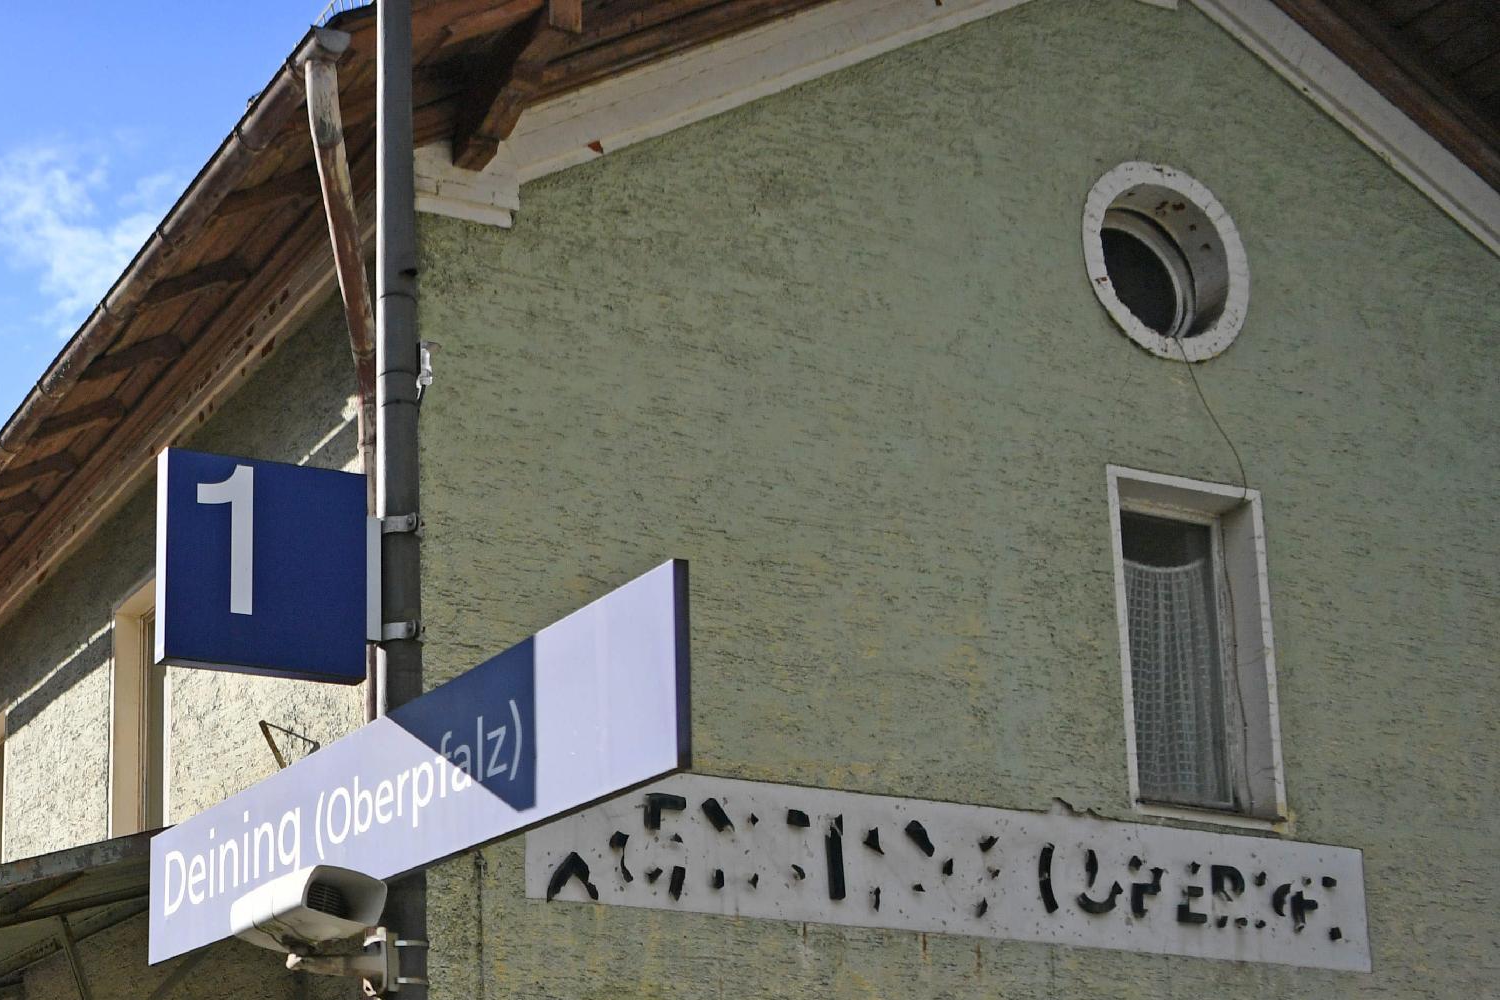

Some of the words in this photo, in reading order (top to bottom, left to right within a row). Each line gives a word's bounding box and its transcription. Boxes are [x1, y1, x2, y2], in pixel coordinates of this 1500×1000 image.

[197, 464, 253, 615] 1
[164, 807, 300, 917] Deining
[315, 700, 523, 860] (Oberpfalz)
